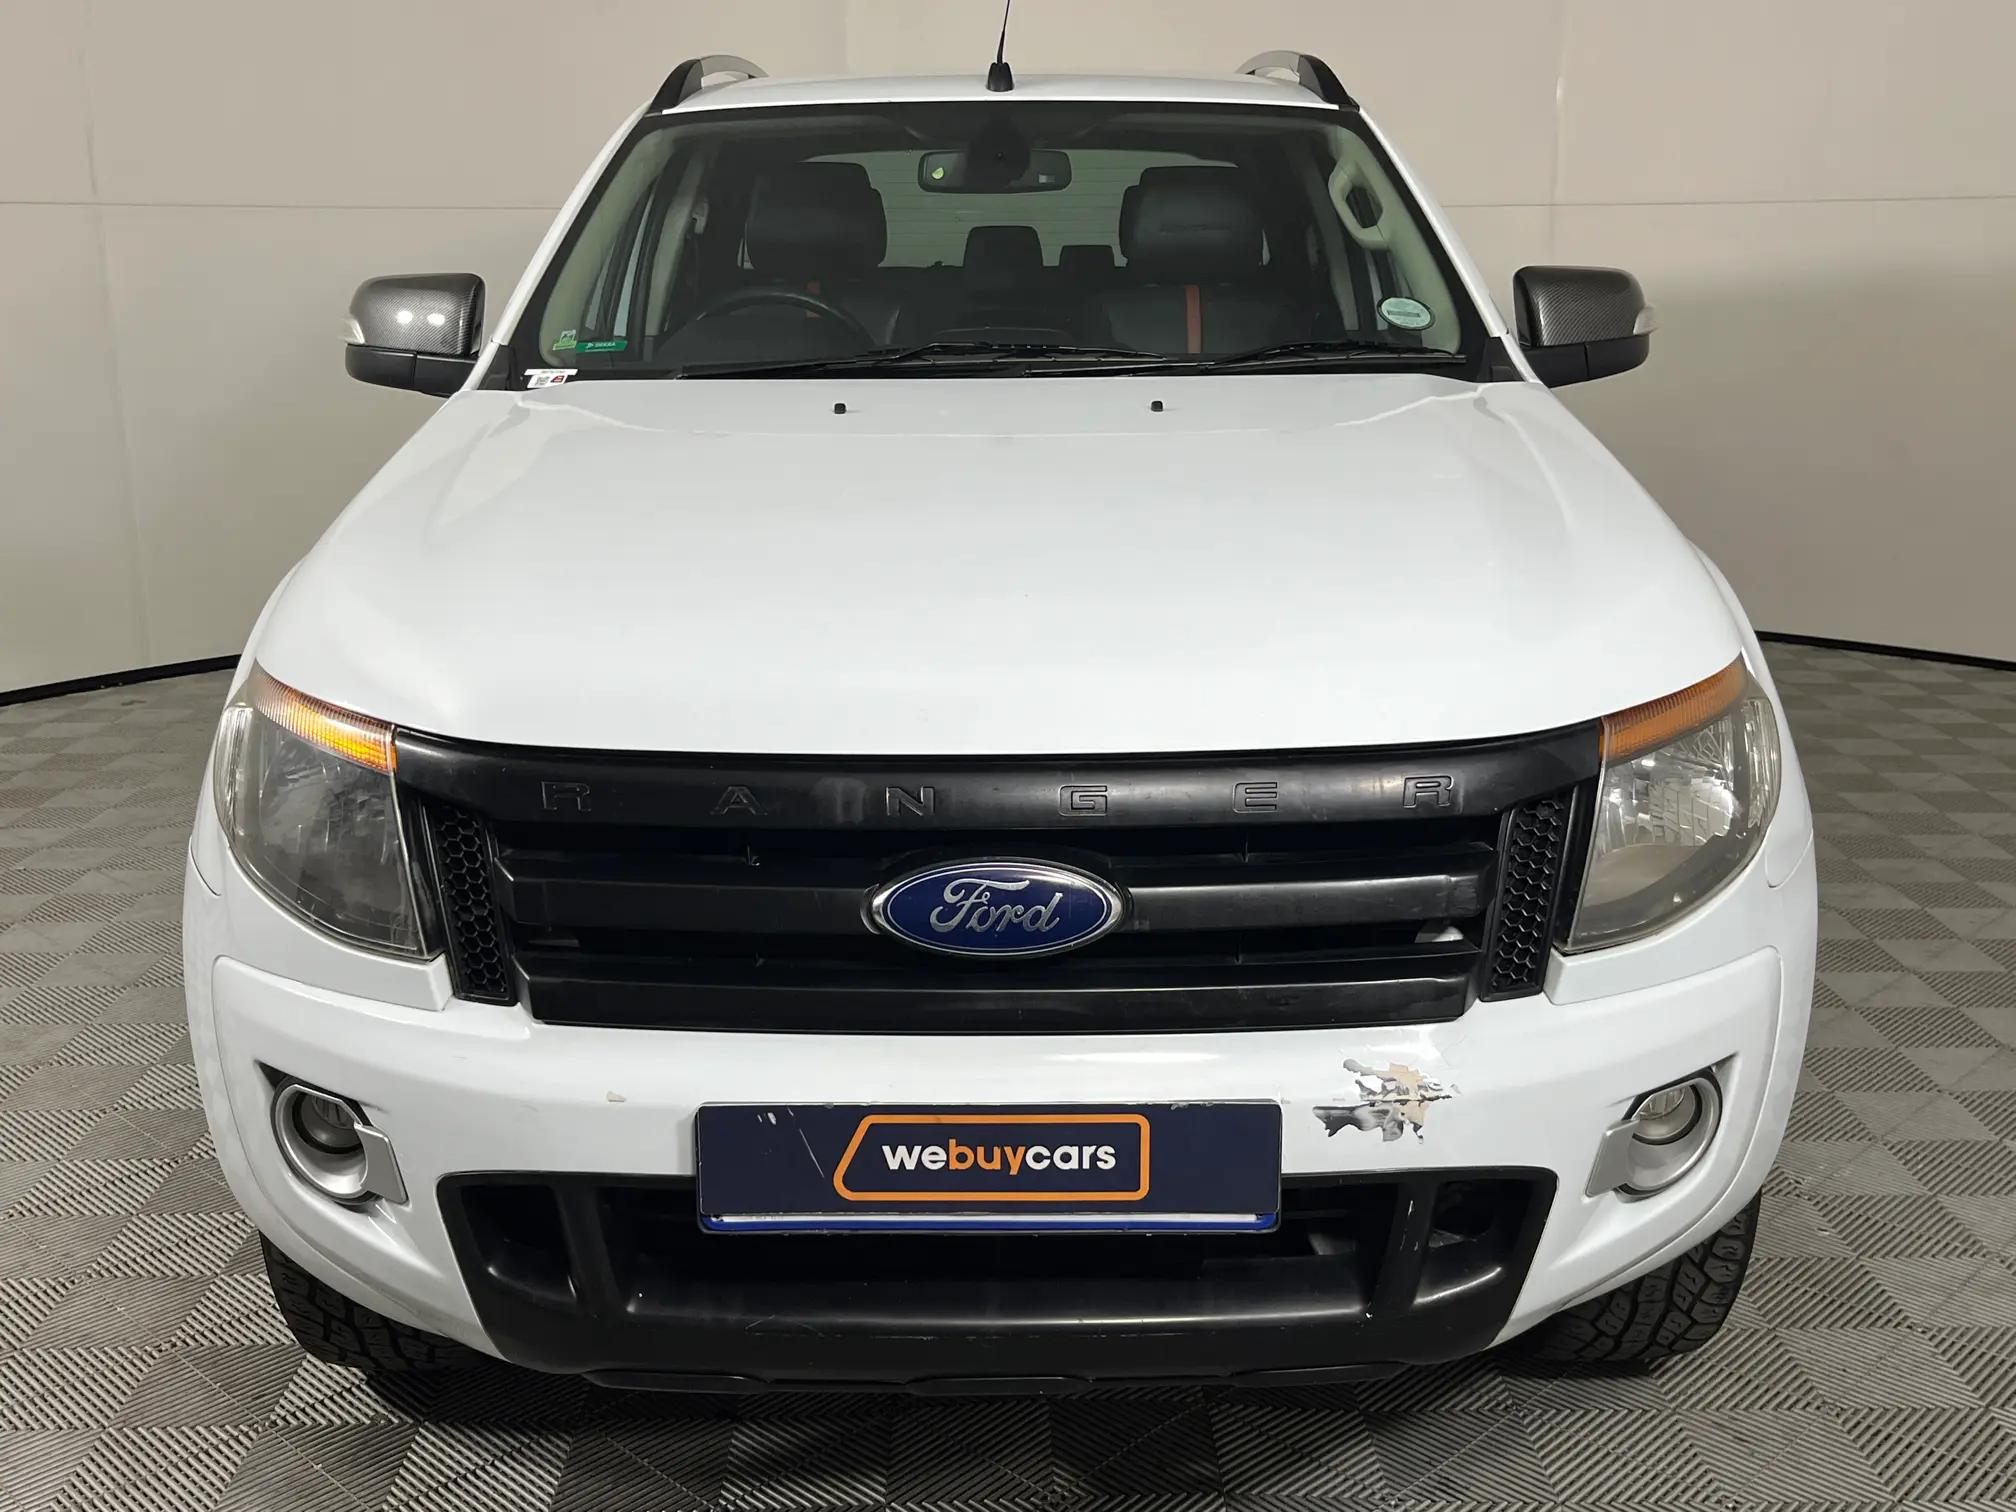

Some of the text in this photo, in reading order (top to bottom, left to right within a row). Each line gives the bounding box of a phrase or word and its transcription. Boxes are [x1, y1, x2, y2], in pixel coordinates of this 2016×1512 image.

[540, 774, 1455, 817] RANGER
[929, 878, 1064, 933] Ford
[881, 1138, 1117, 1176] webuycars
